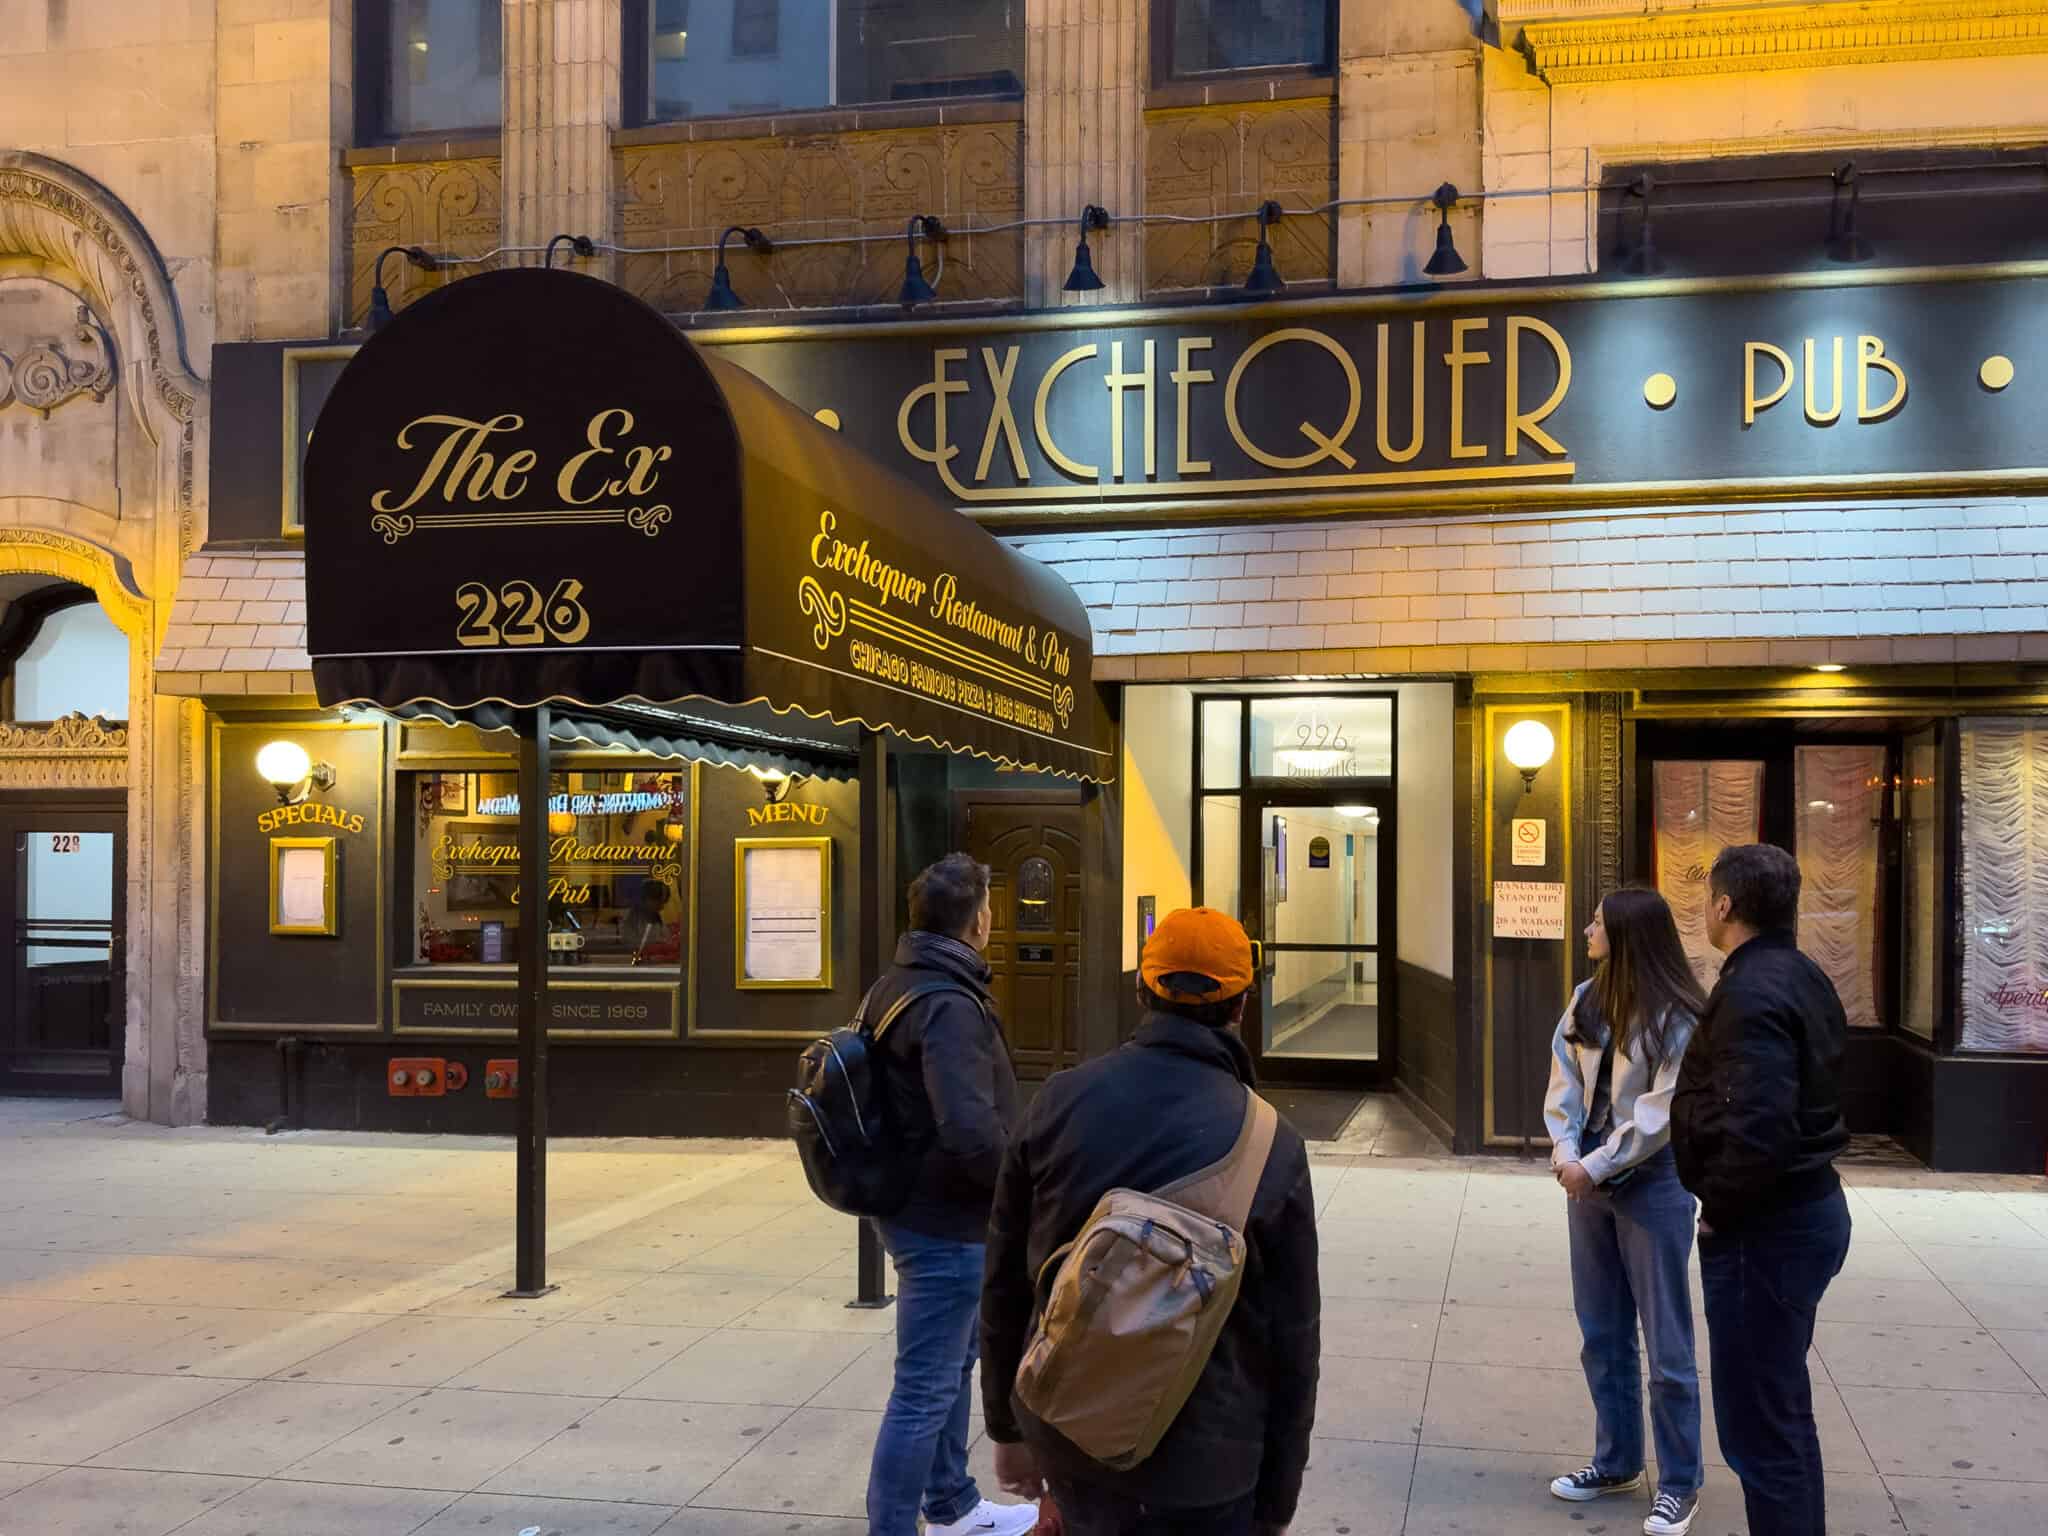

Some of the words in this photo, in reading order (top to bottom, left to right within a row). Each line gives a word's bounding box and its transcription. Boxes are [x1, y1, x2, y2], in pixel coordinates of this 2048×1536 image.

[897, 314, 1577, 501] EXCHEQUER
[1744, 334, 1909, 425] PUB
[371, 413, 537, 512] The
[557, 408, 672, 504] Ex
[811, 510, 927, 607] Exchequer
[930, 572, 1024, 654] Restaurant
[1025, 624, 1037, 665] &
[1041, 631, 1070, 677] Pub
[455, 578, 590, 646] 226
[849, 639, 909, 685] CHICAGO
[910, 660, 956, 702] FAMOUS
[957, 678, 985, 712] PIZZA
[257, 803, 365, 833] SPECIALS
[746, 801, 829, 827] MENU
[432, 834, 521, 866] Exchequ
[550, 836, 677, 861] Restaurant
[549, 877, 591, 904] Pub
[1519, 904, 1540, 913] FOR
[1521, 918, 1563, 928] WABASH
[423, 1002, 482, 1017] FAMILY
[551, 1004, 601, 1019] SINCE
[606, 1004, 649, 1020] 1969
